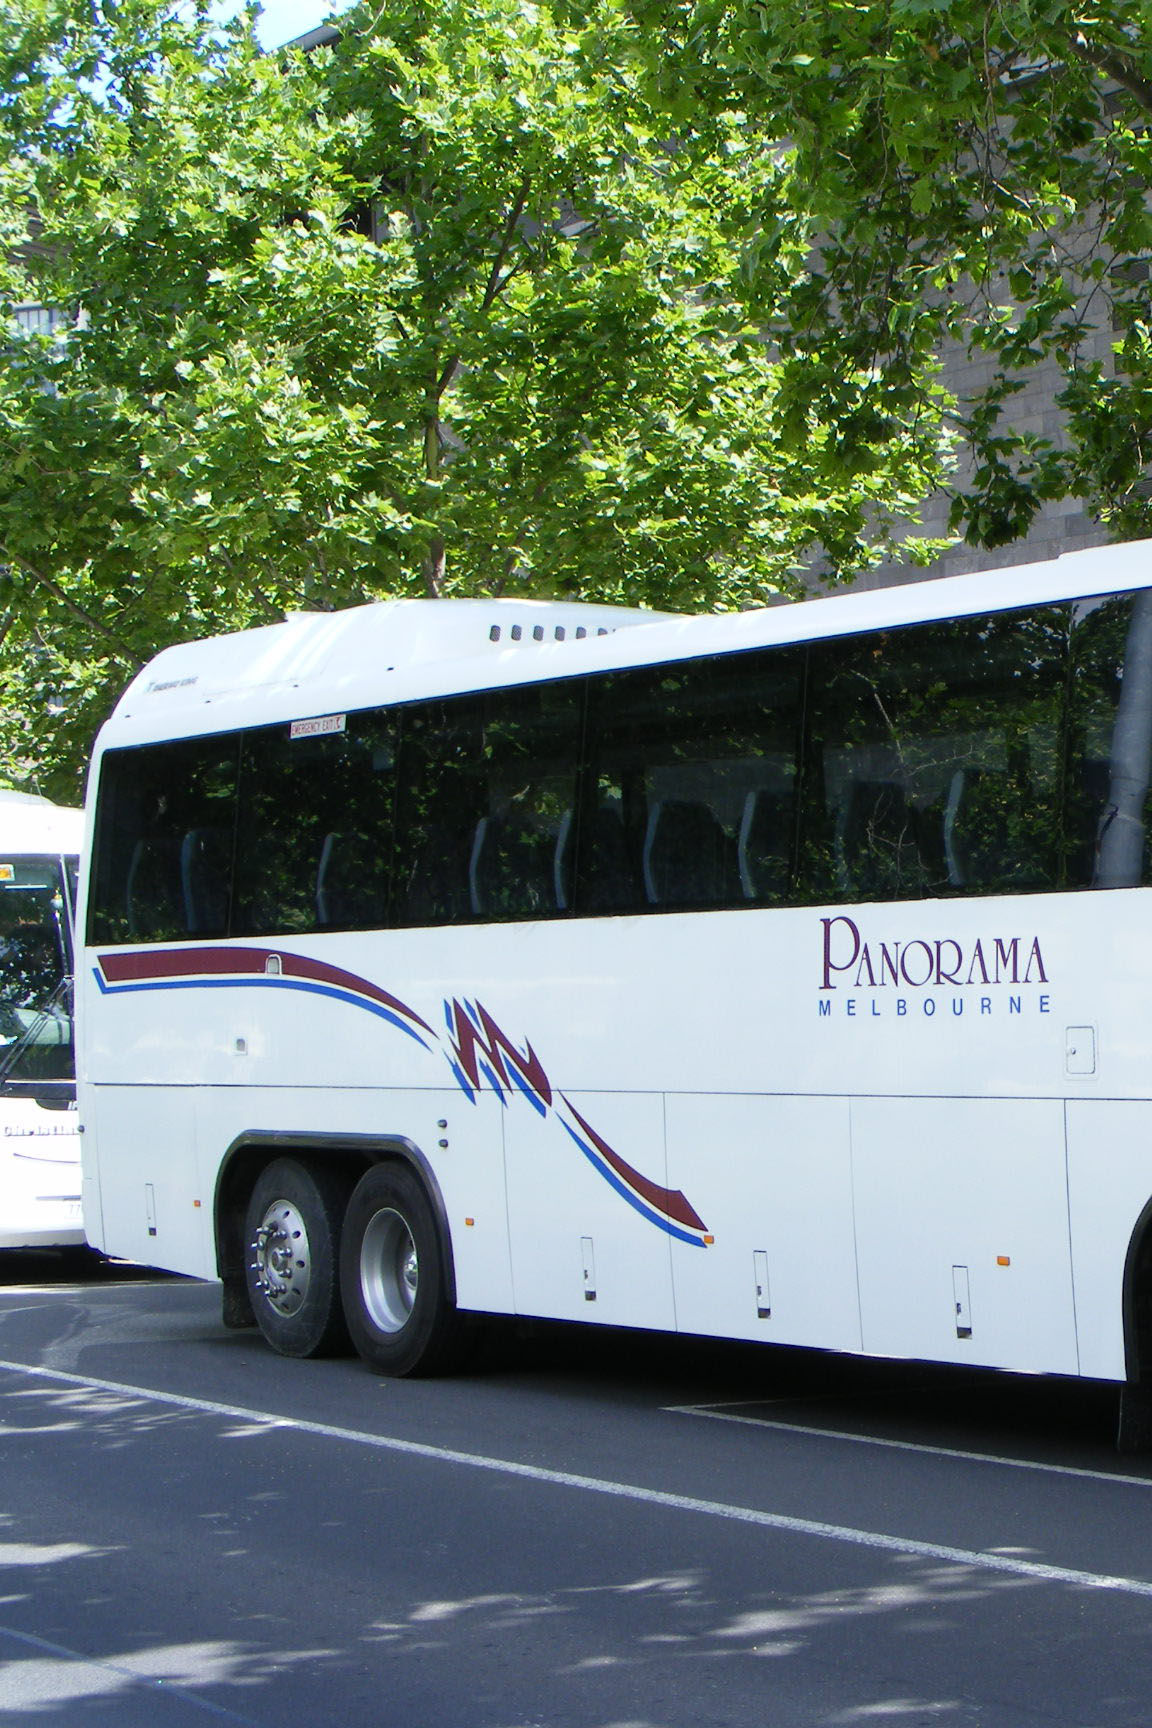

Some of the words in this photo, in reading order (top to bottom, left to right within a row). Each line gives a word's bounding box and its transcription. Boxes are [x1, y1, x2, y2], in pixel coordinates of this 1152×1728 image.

[292, 720, 320, 736] EMERGENCY
[322, 717, 334, 732] EXIT
[818, 916, 1050, 990] PANORAMA
[818, 995, 1050, 1017] MELBOURNE
